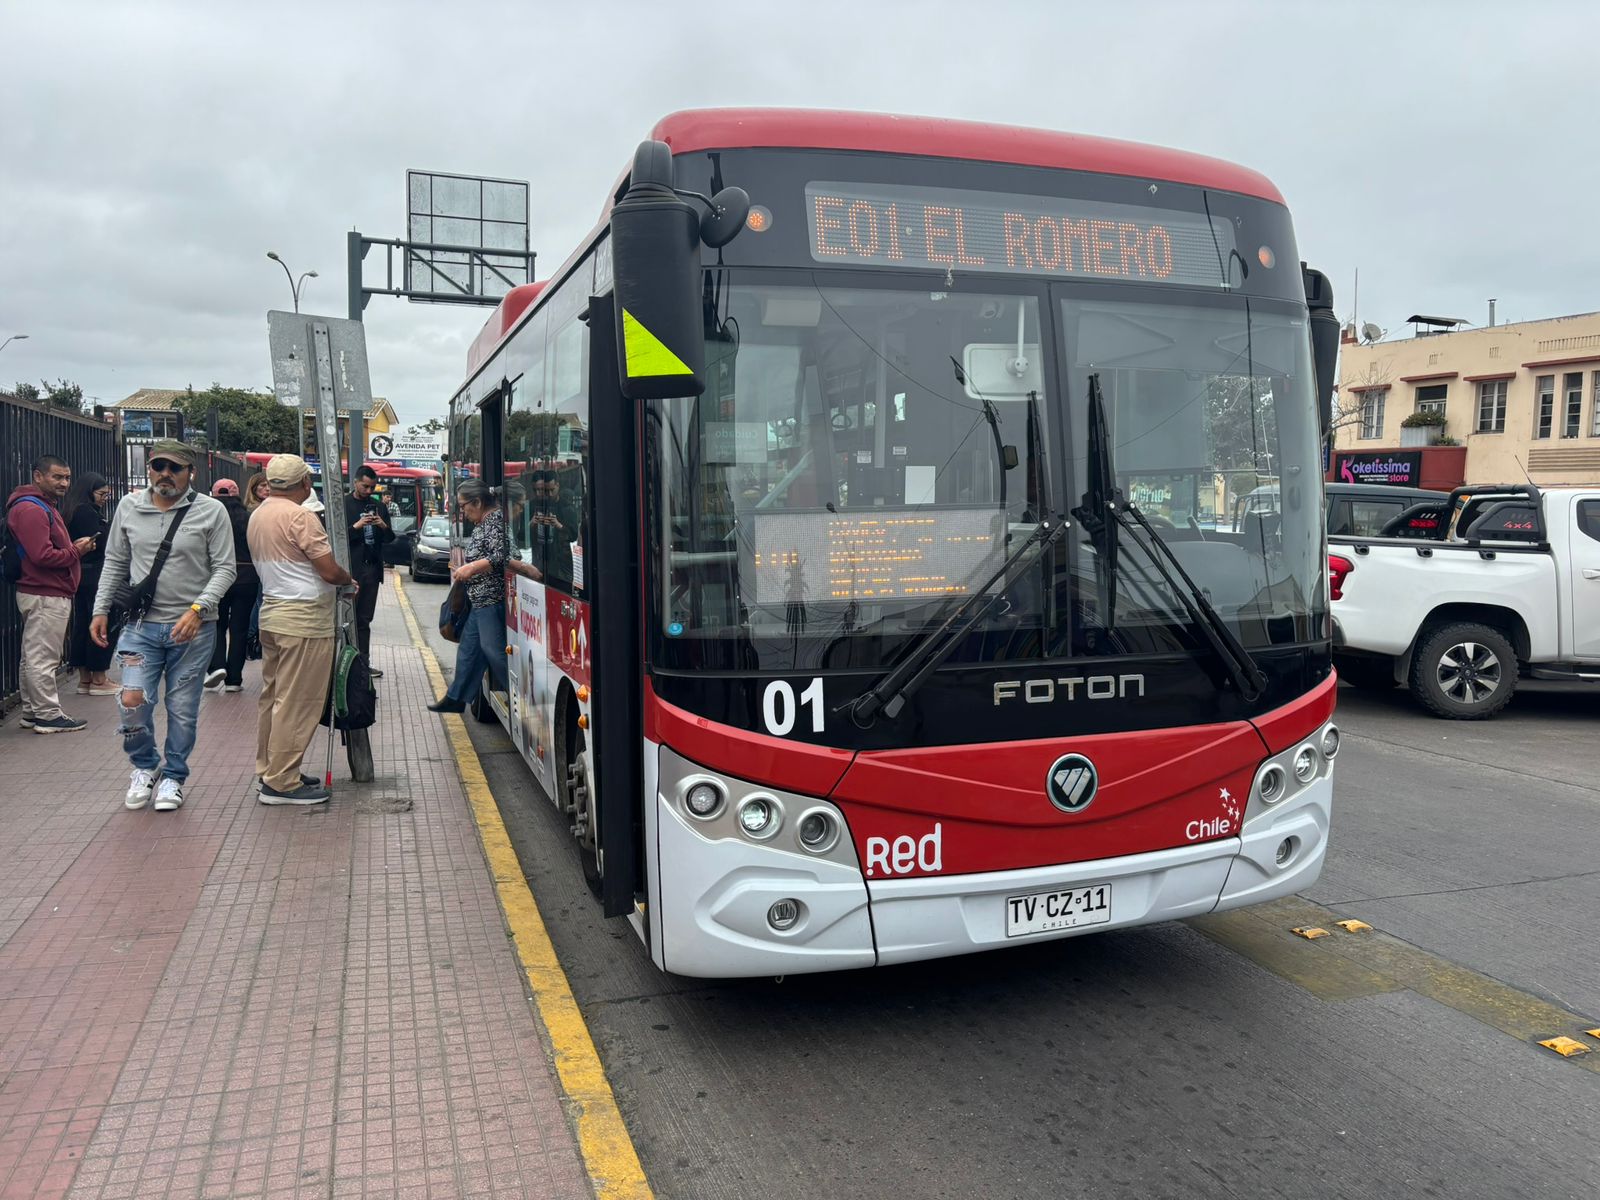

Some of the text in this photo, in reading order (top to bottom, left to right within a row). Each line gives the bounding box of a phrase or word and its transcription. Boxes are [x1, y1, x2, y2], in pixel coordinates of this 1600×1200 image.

[814, 196, 1173, 279] E01 EL ROMERO
[1389, 474, 1409, 482] store
[1503, 520, 1533, 530] 4x4
[993, 673, 1145, 706] FOTON
[763, 677, 825, 736] 01
[1185, 817, 1230, 841] Chile
[866, 822, 943, 876] Red
[1042, 918, 1078, 930] CHILE
